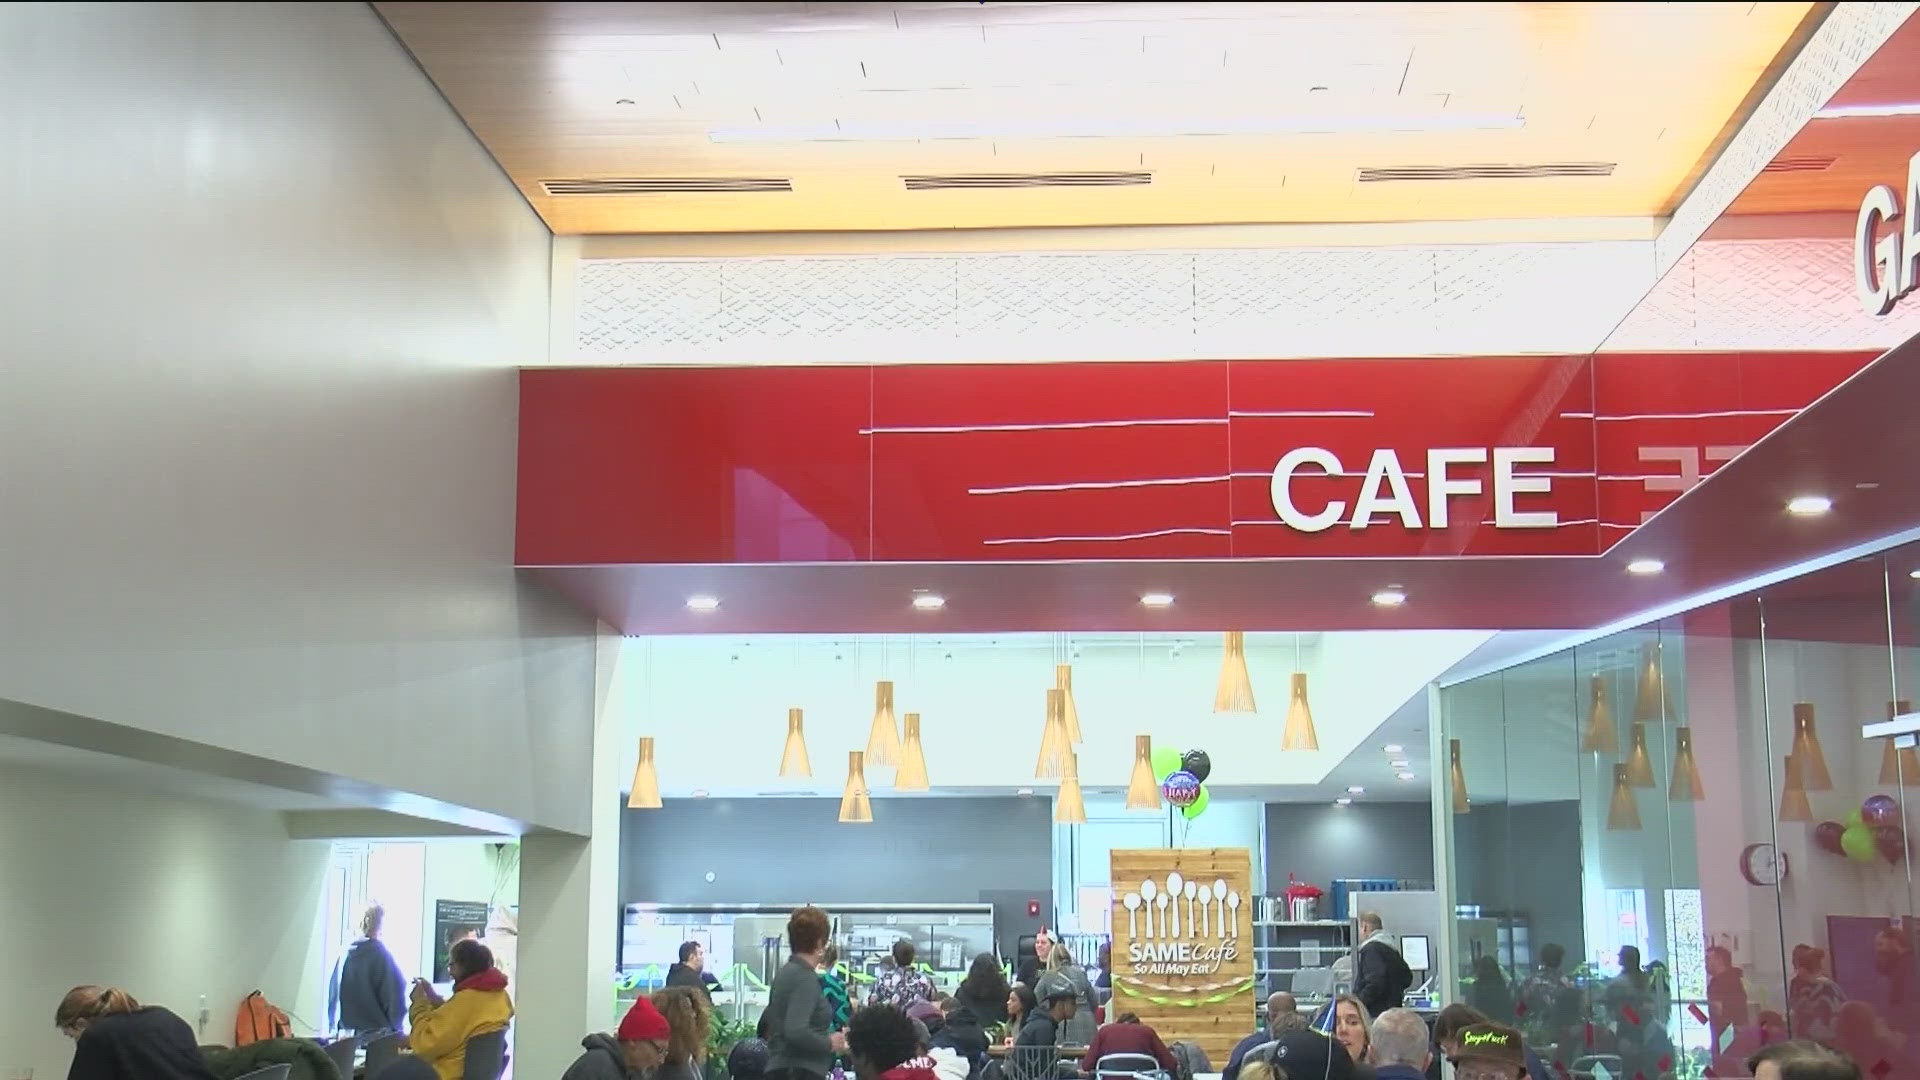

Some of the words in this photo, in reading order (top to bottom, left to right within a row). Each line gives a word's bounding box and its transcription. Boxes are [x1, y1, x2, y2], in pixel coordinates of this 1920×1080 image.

[1270, 447, 1558, 531] CAFE
[1129, 942, 1191, 962] SAME
[1191, 939, 1239, 974] Café
[1133, 963, 1148, 974] So
[1149, 963, 1165, 974] All
[1165, 963, 1190, 976] May
[1191, 963, 1210, 974] Eat
